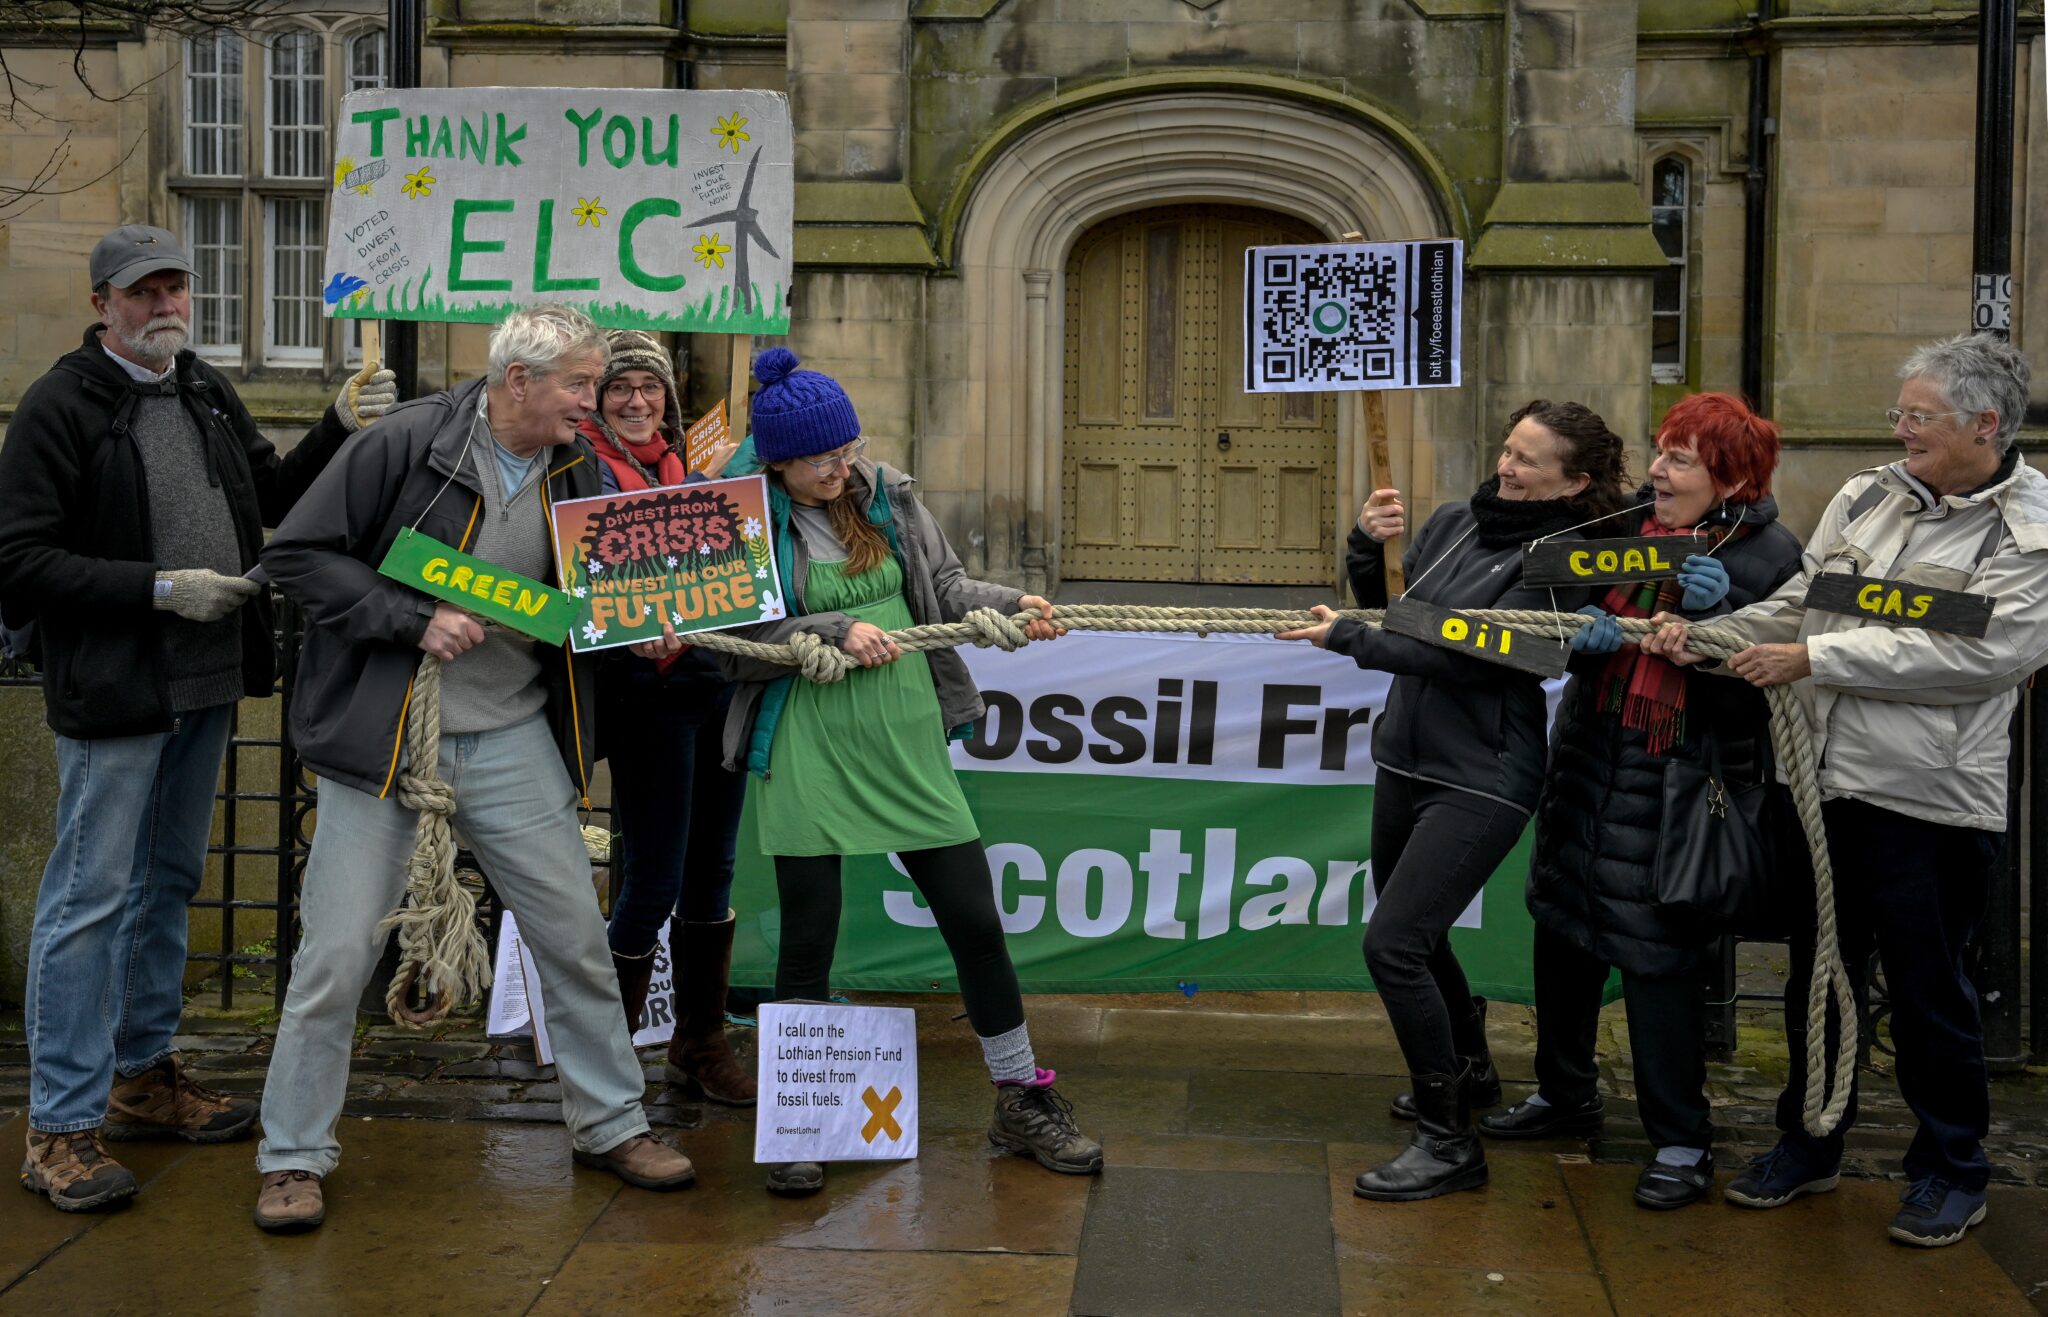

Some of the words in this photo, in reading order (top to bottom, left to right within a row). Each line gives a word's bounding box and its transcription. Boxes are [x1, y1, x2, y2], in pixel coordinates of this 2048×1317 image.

[352, 107, 527, 166] THANK
[565, 107, 680, 168] YOU
[691, 184, 701, 192] IN
[706, 174, 726, 187] OUR
[693, 164, 725, 180] INVEST
[699, 182, 732, 200] FUTURE
[345, 210, 389, 243] VOTED
[358, 226, 396, 258] DIVEST
[368, 242, 401, 271] FROM
[448, 198, 686, 292] ELC
[375, 255, 410, 285] CRISIS
[1429, 250, 1445, 379] bit.ly/foeeastlothian
[691, 416, 721, 446] CRISIS
[605, 506, 666, 528] DIVEST
[670, 501, 718, 517] FROM
[598, 515, 732, 565] CRISIS
[591, 575, 668, 594] INVEST
[675, 570, 697, 586] IN
[702, 559, 747, 580] OUR
[1569, 546, 1671, 577] COAL
[422, 557, 549, 616] GREEN
[1856, 583, 1934, 618] GAS
[591, 573, 756, 631] FUTURE
[961, 677, 1217, 766] ossil
[1257, 683, 1386, 771] Fr
[882, 828, 1484, 941] cotlan
[648, 979, 672, 995] OU
[778, 1022, 782, 1037] I
[785, 1022, 806, 1037] call
[809, 1026, 824, 1037] on
[827, 1024, 845, 1038] the
[778, 1045, 822, 1060] Lothian
[825, 1046, 871, 1061] Pension
[875, 1047, 902, 1061] Fund
[777, 1069, 788, 1083] to
[791, 1069, 826, 1083] divest
[829, 1069, 856, 1083] from
[777, 1091, 809, 1107] fossil
[812, 1092, 843, 1107] fuels.
[776, 1126, 821, 1135] #DivestLothian
